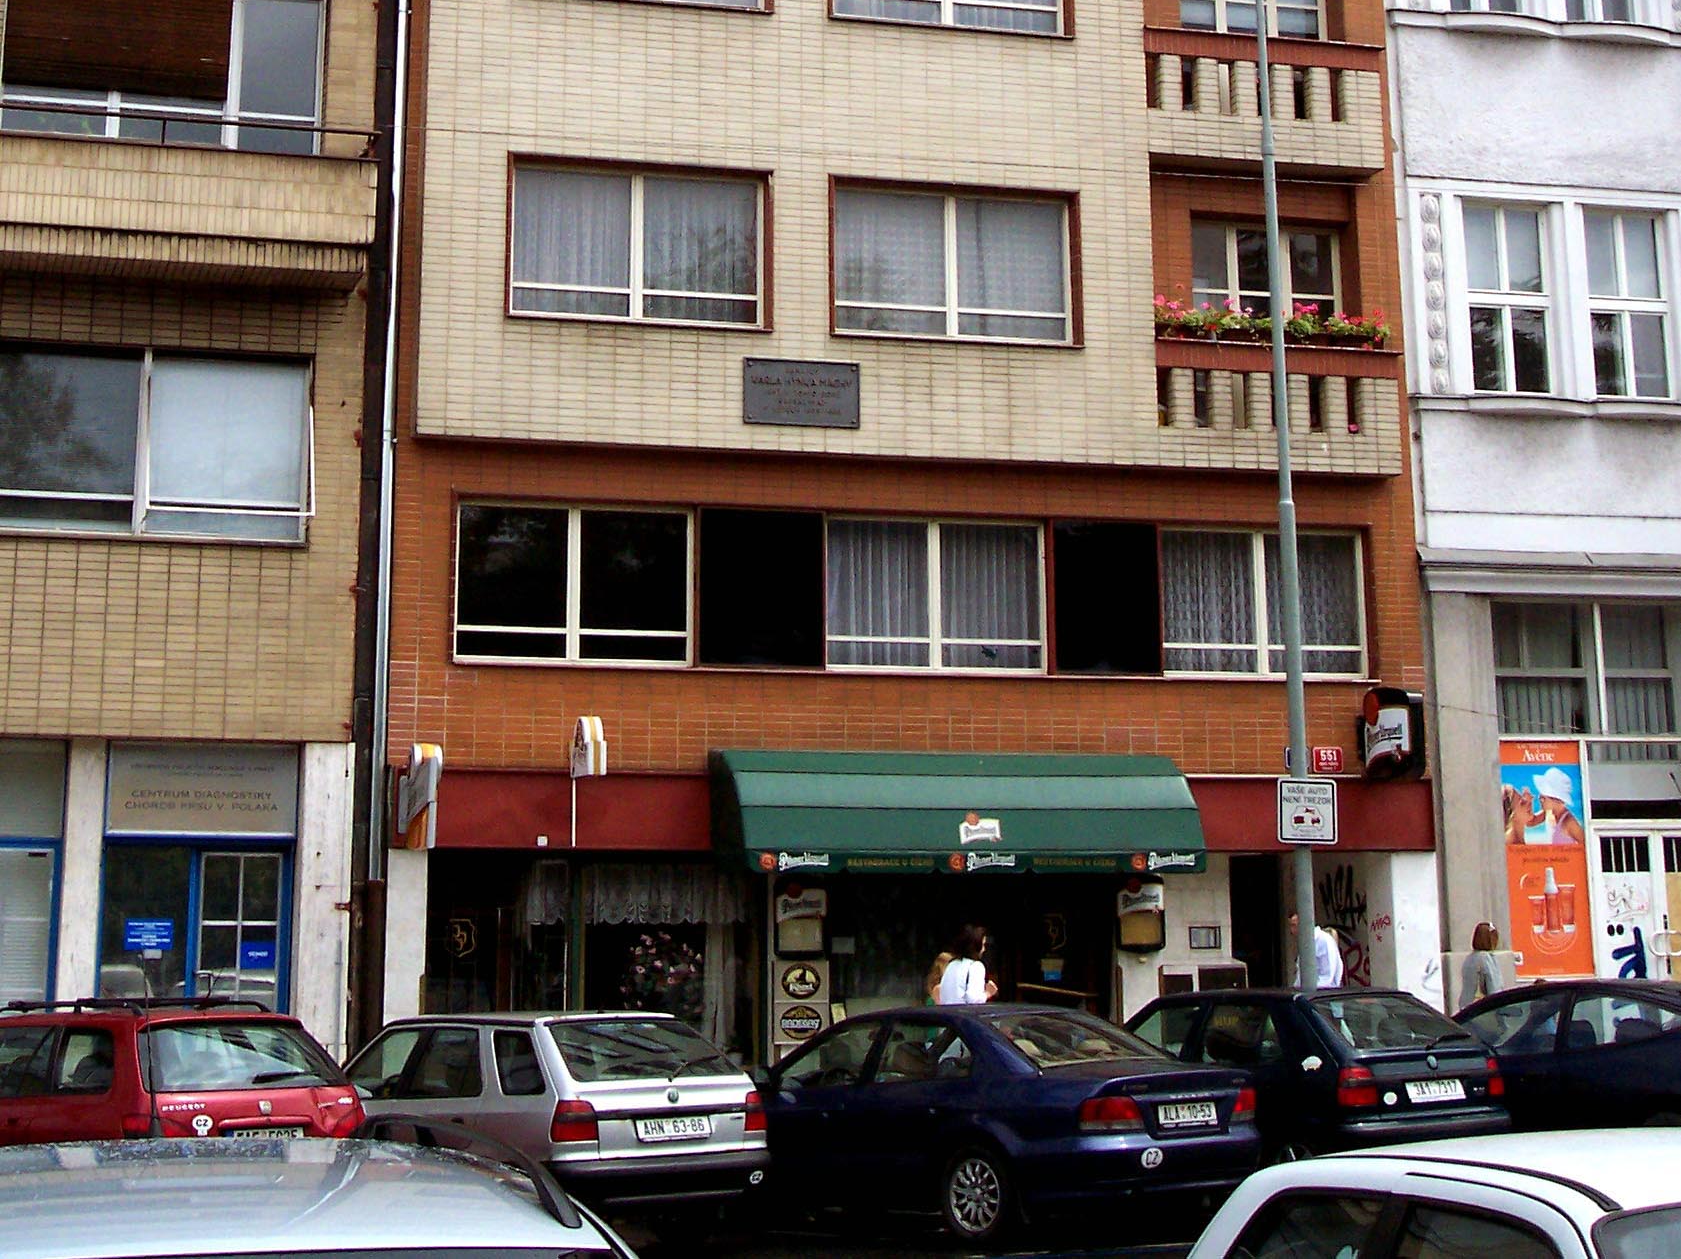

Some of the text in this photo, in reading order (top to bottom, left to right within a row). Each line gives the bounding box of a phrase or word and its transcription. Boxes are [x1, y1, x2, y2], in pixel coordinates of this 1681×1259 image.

[1320, 750, 1337, 762] 551
[1522, 750, 1556, 762] Avène
[1308, 786, 1328, 795] AUTO
[1186, 1102, 1211, 1119] 10-53
[195, 1118, 208, 1128] CZ
[643, 1118, 705, 1136] AHN 63-86
[1145, 1151, 1159, 1165] CZ
